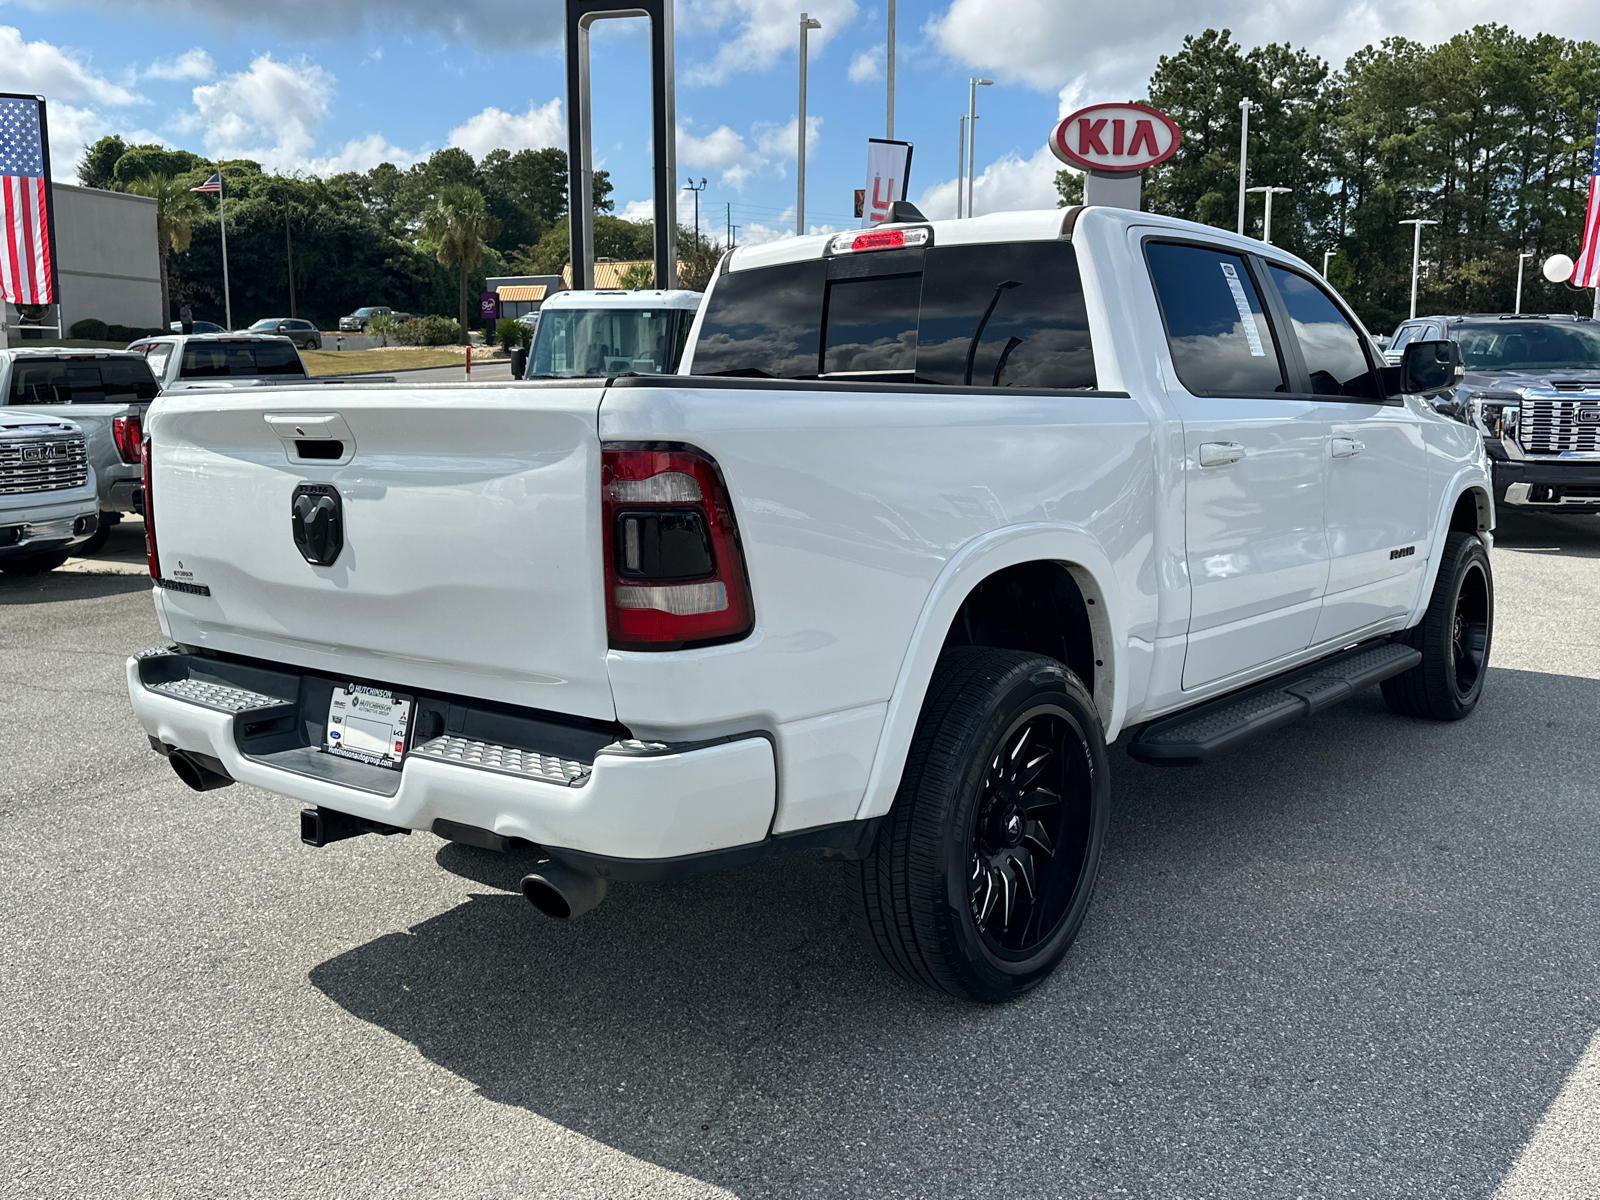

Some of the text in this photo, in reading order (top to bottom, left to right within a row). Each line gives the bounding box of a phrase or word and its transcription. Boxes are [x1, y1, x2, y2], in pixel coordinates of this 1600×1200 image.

[1078, 119, 1160, 156] KIA
[24, 445, 67, 461] GMC
[300, 485, 329, 493] RAM
[1390, 545, 1416, 560] RAM
[355, 684, 393, 699] HUTCHINSON
[359, 699, 392, 712] HUTCHINSON
